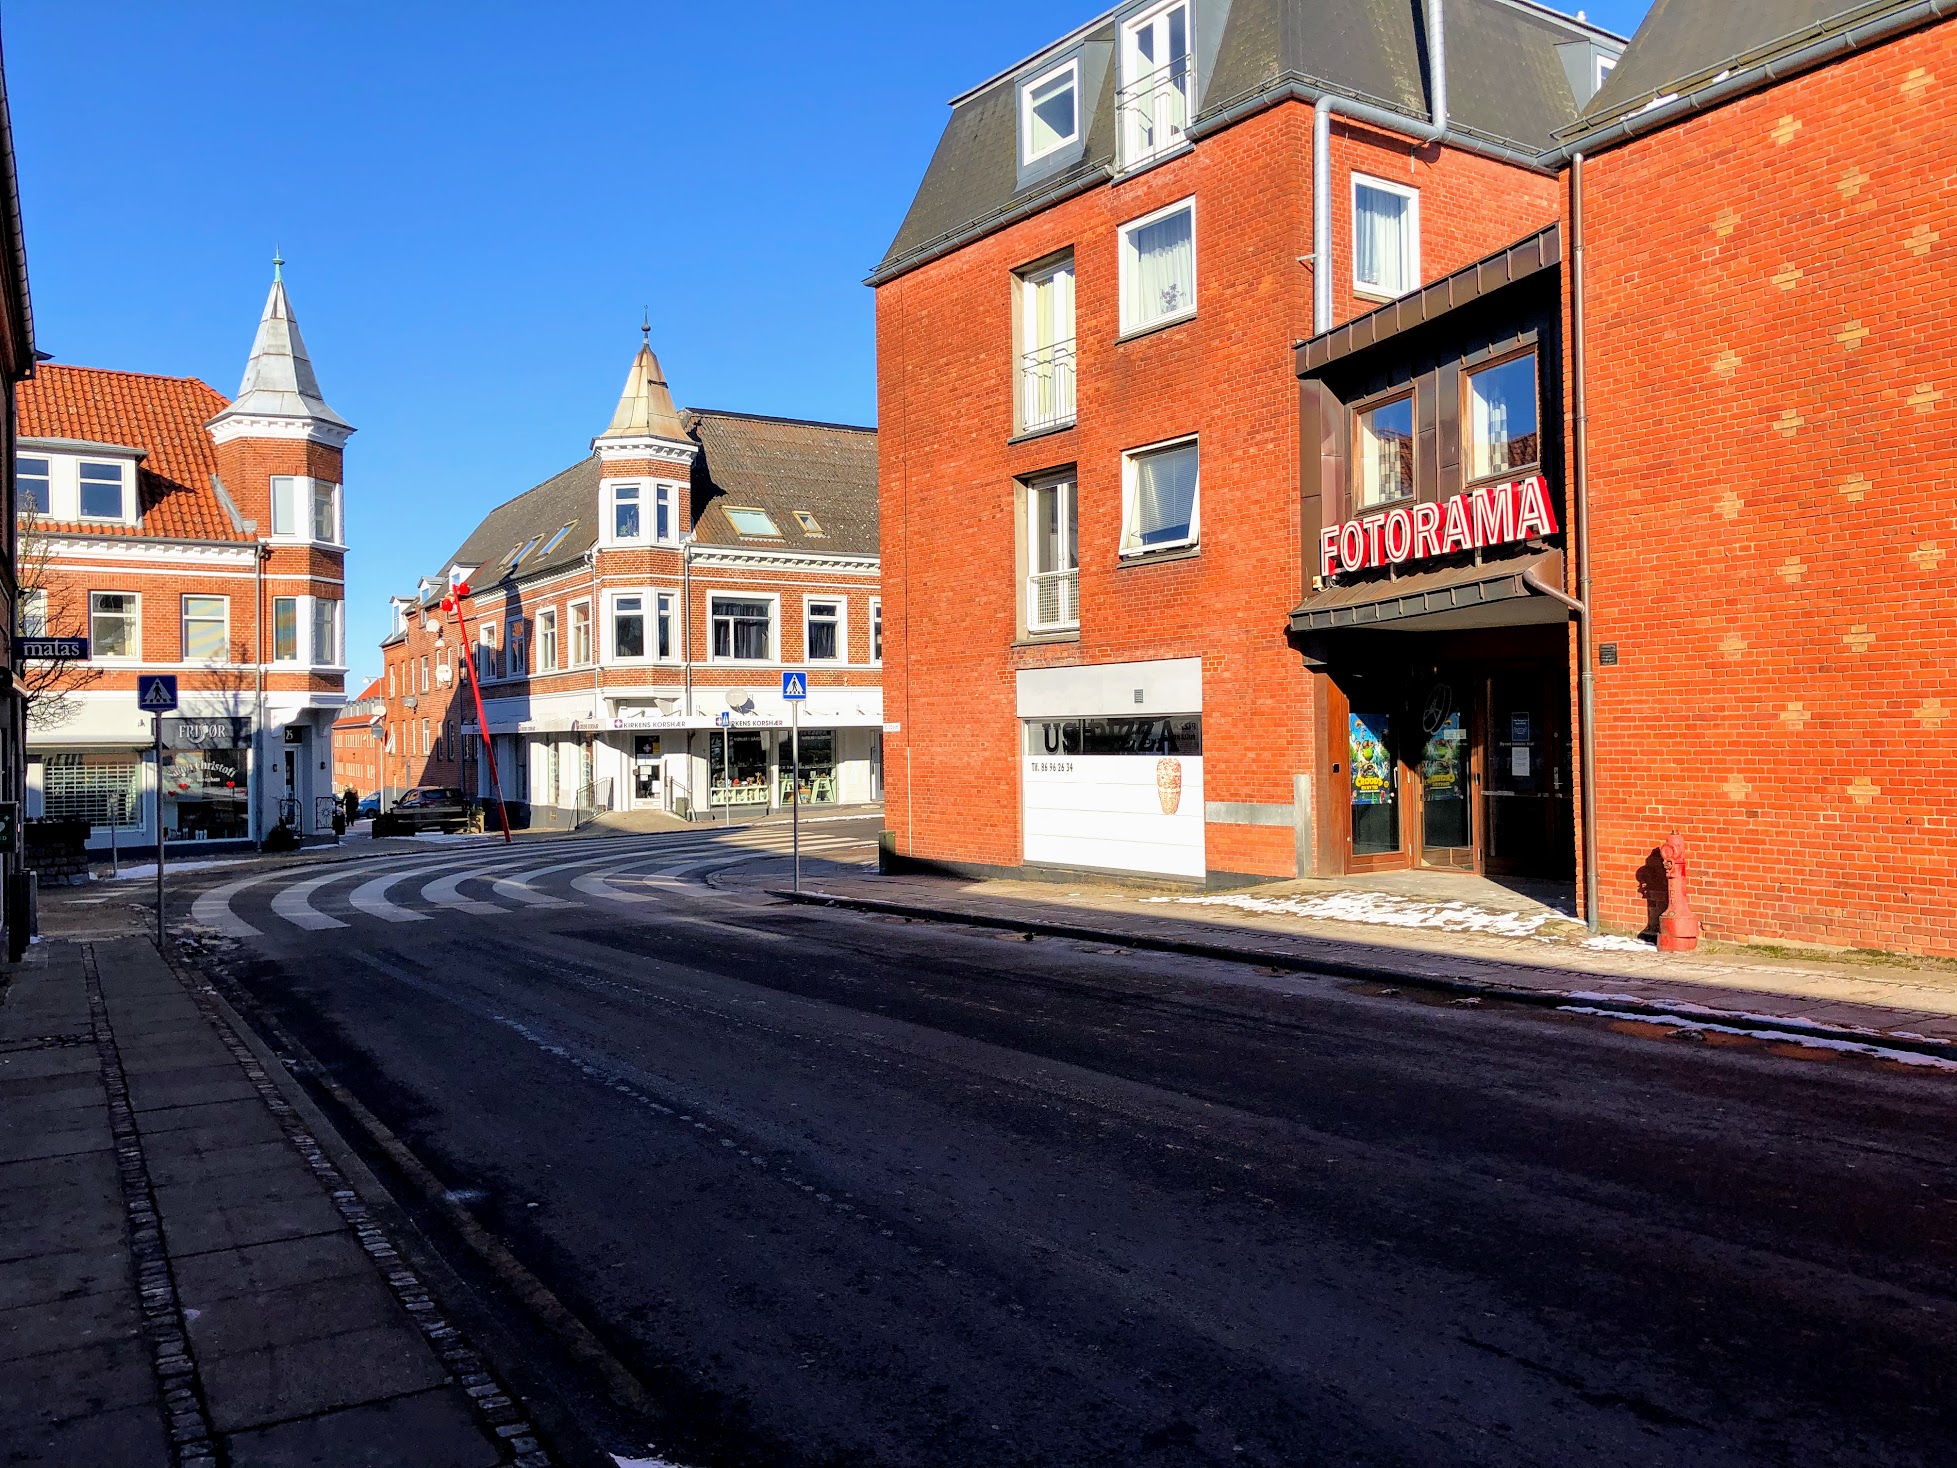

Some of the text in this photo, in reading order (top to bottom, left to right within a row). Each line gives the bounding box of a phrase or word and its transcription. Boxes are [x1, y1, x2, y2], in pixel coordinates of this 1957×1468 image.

[1320, 476, 1559, 577] FOTORAMA
[23, 639, 80, 656] matas
[285, 729, 294, 740] 25
[1042, 722, 1079, 753] US
[1041, 762, 1048, 771] 86
[1049, 762, 1056, 771] 96
[1058, 762, 1065, 771] 26
[1066, 762, 1073, 772] 34
